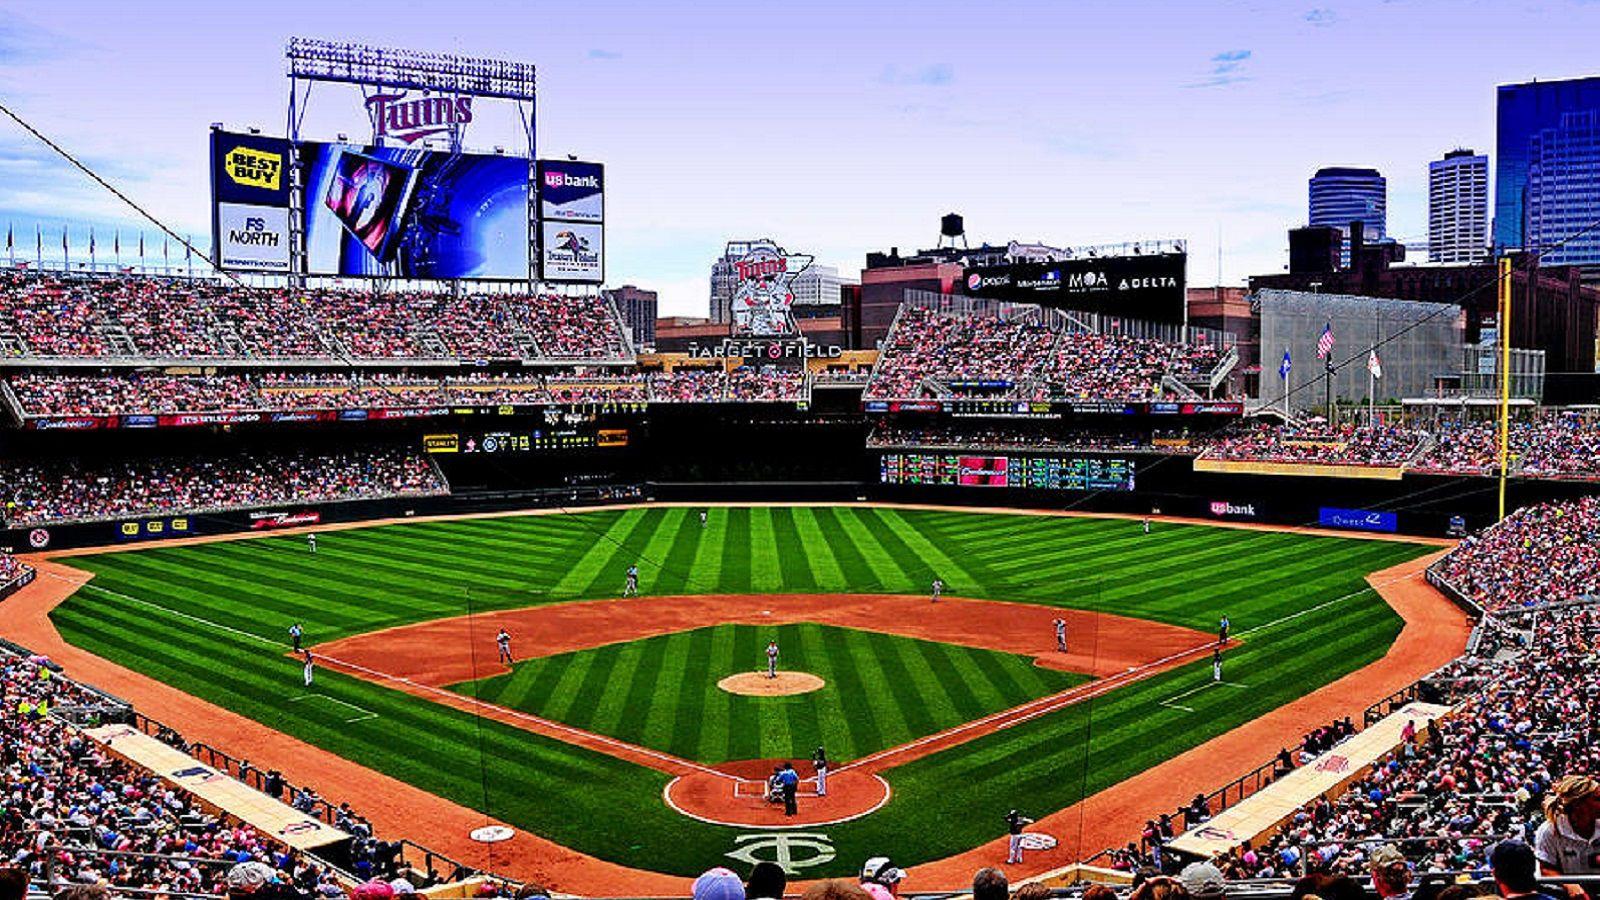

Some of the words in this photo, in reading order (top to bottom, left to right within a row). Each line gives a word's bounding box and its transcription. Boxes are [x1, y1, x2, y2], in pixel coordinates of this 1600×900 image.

[365, 91, 472, 136] Twins
[233, 153, 280, 171] BEST
[234, 166, 274, 183] BUY
[246, 217, 265, 231] FS
[230, 230, 279, 246] NORTH
[735, 257, 788, 281] Twins
[1131, 277, 1177, 288] DELTA
[689, 345, 765, 358] TARGET
[785, 345, 842, 358] FIELD
